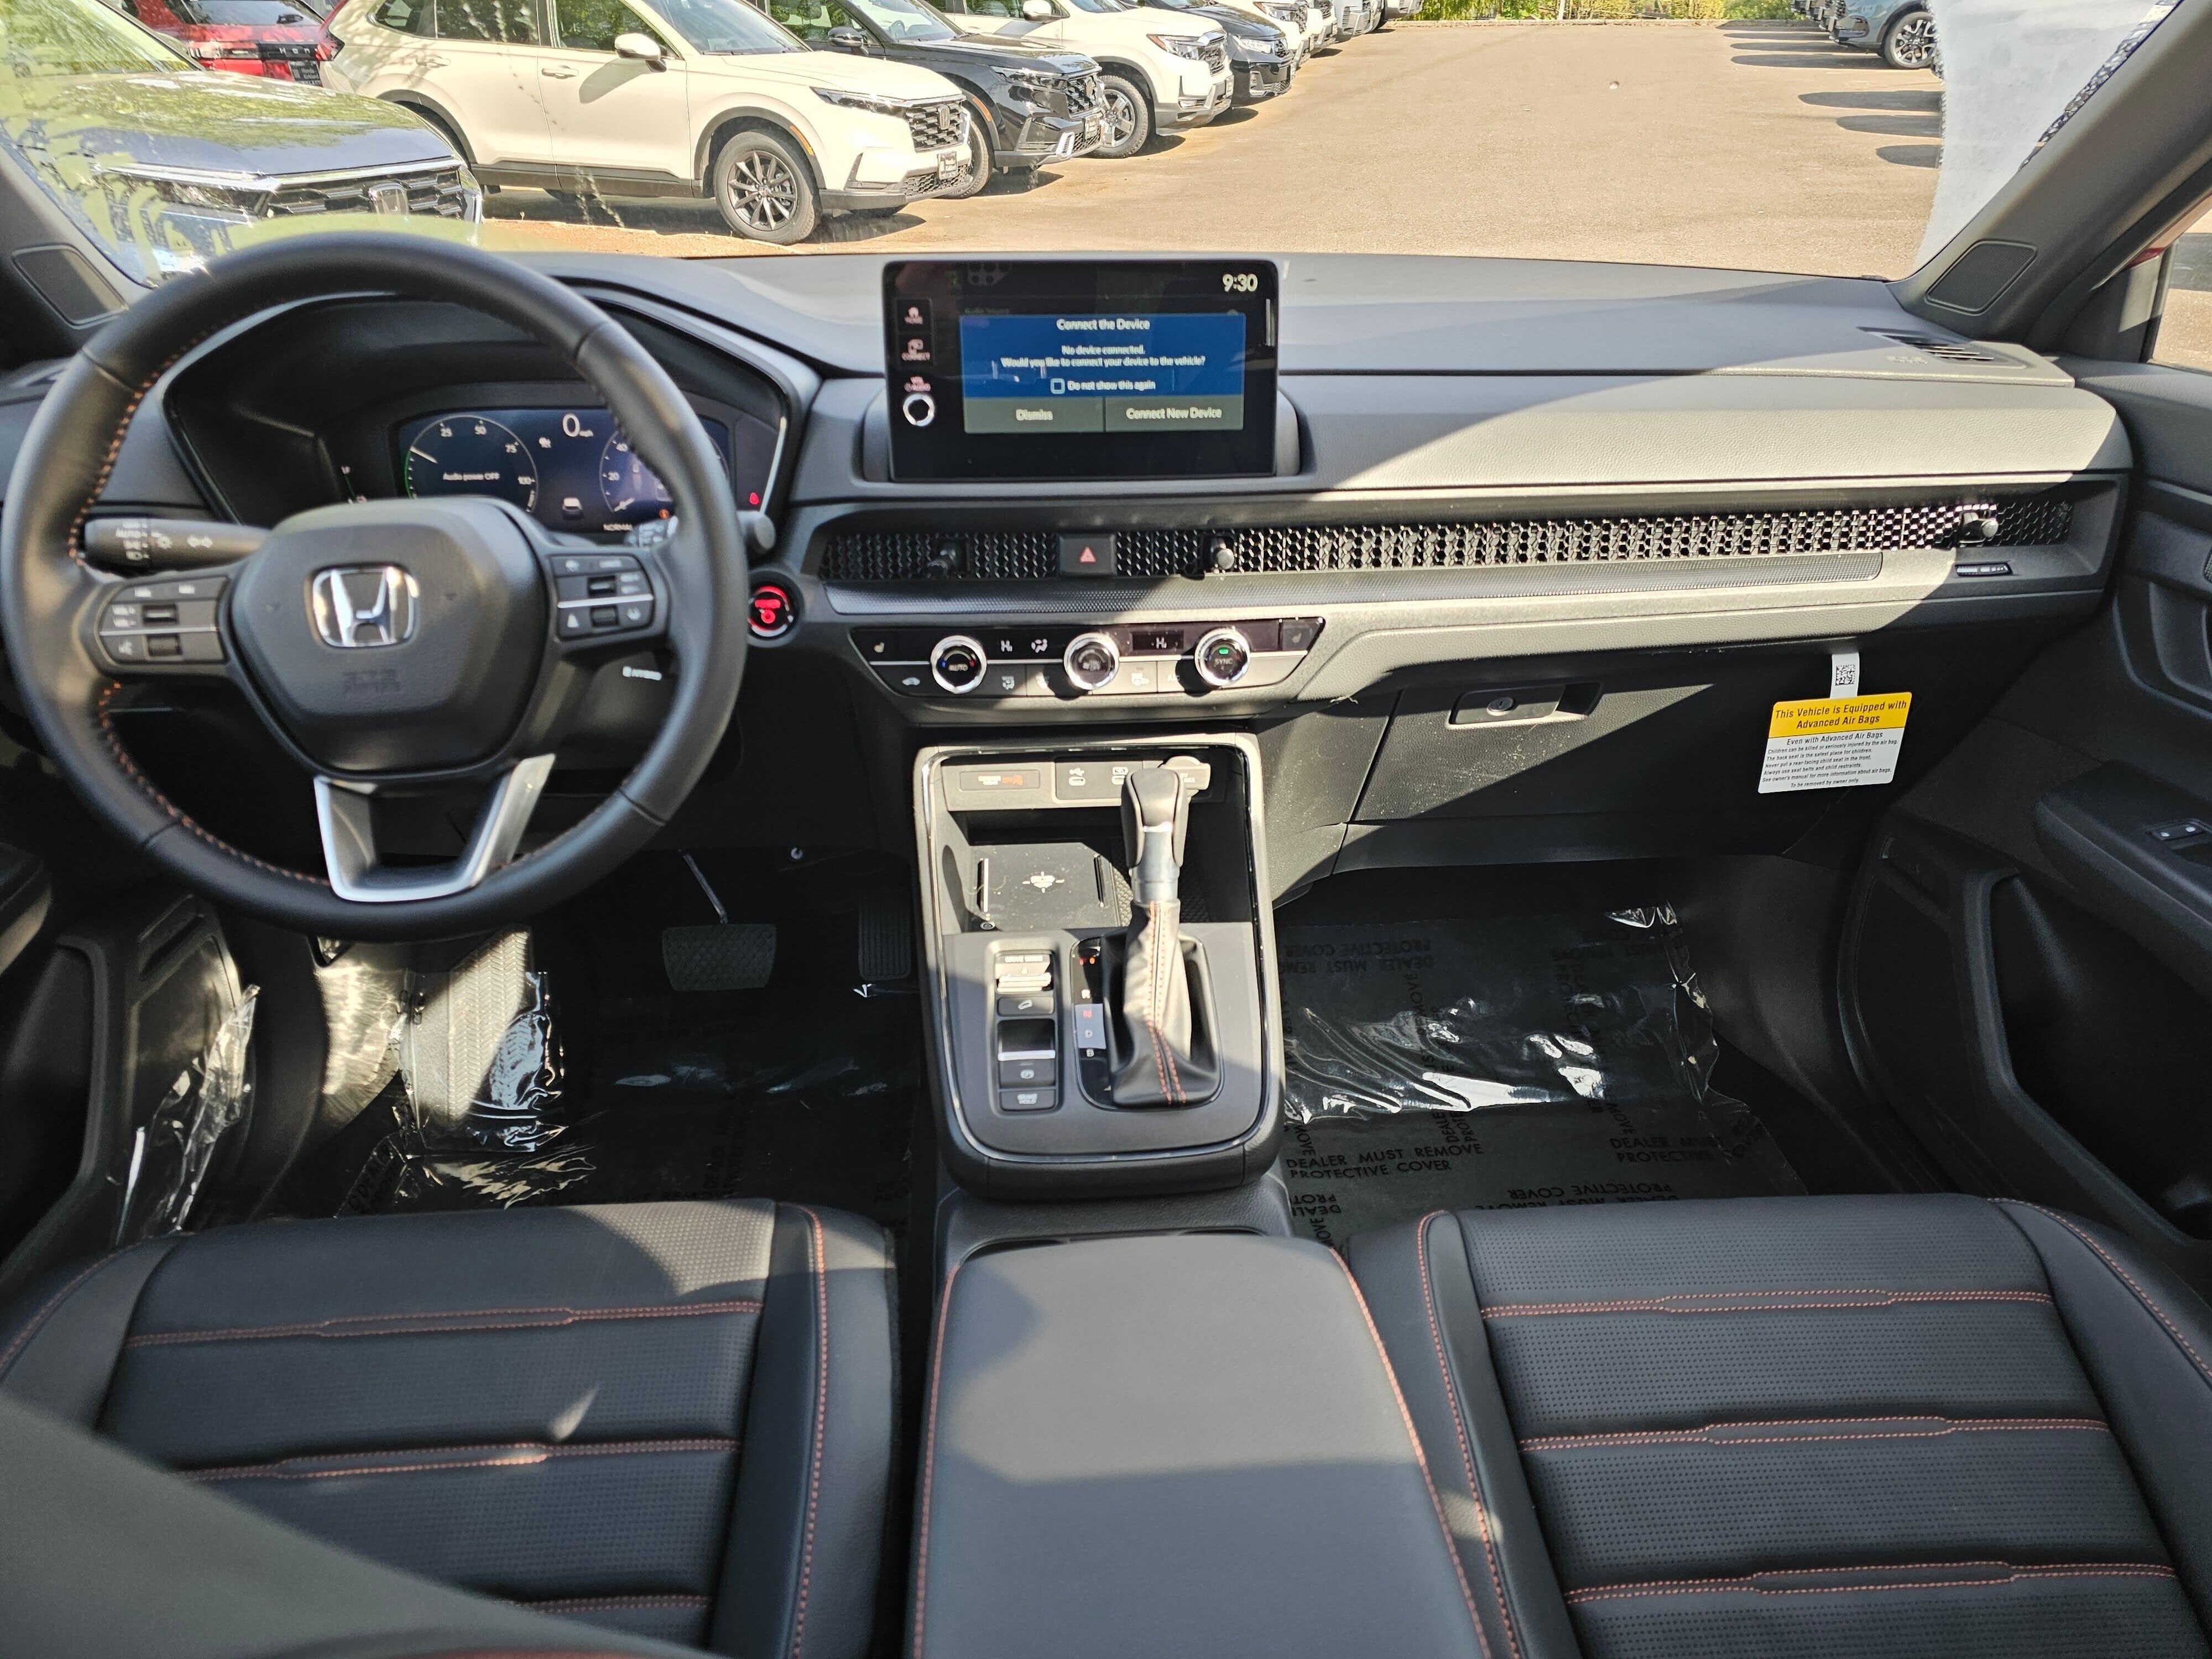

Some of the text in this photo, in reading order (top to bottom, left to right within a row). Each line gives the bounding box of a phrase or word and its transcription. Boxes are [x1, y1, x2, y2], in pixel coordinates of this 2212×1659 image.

[1223, 274, 1258, 291] 9:30
[1057, 319, 1150, 330] Connect the Device
[1061, 345, 1075, 354] No
[1076, 345, 1101, 354] device
[1000, 358, 1029, 367] Would
[1071, 357, 1102, 367] connect
[1123, 357, 1149, 367] device
[1067, 380, 1080, 390] Do
[1096, 380, 1117, 390] show
[1118, 380, 1133, 390] this
[1134, 380, 1155, 391] again
[1015, 409, 1053, 420] Dismiss
[1126, 407, 1222, 420] Connect New Device
[474, 425, 487, 435] 50
[1776, 701, 1907, 718] This Vehicle is Equipped with
[1796, 715, 1880, 729] Advanced Air Bags
[1820, 733, 1853, 742] Advanced
[1286, 1143, 1484, 1168] DEALER MUST REMOVE
[1290, 1160, 1452, 1179] PROTECTIVE COVER
[1507, 1187, 1564, 1199] COVER
